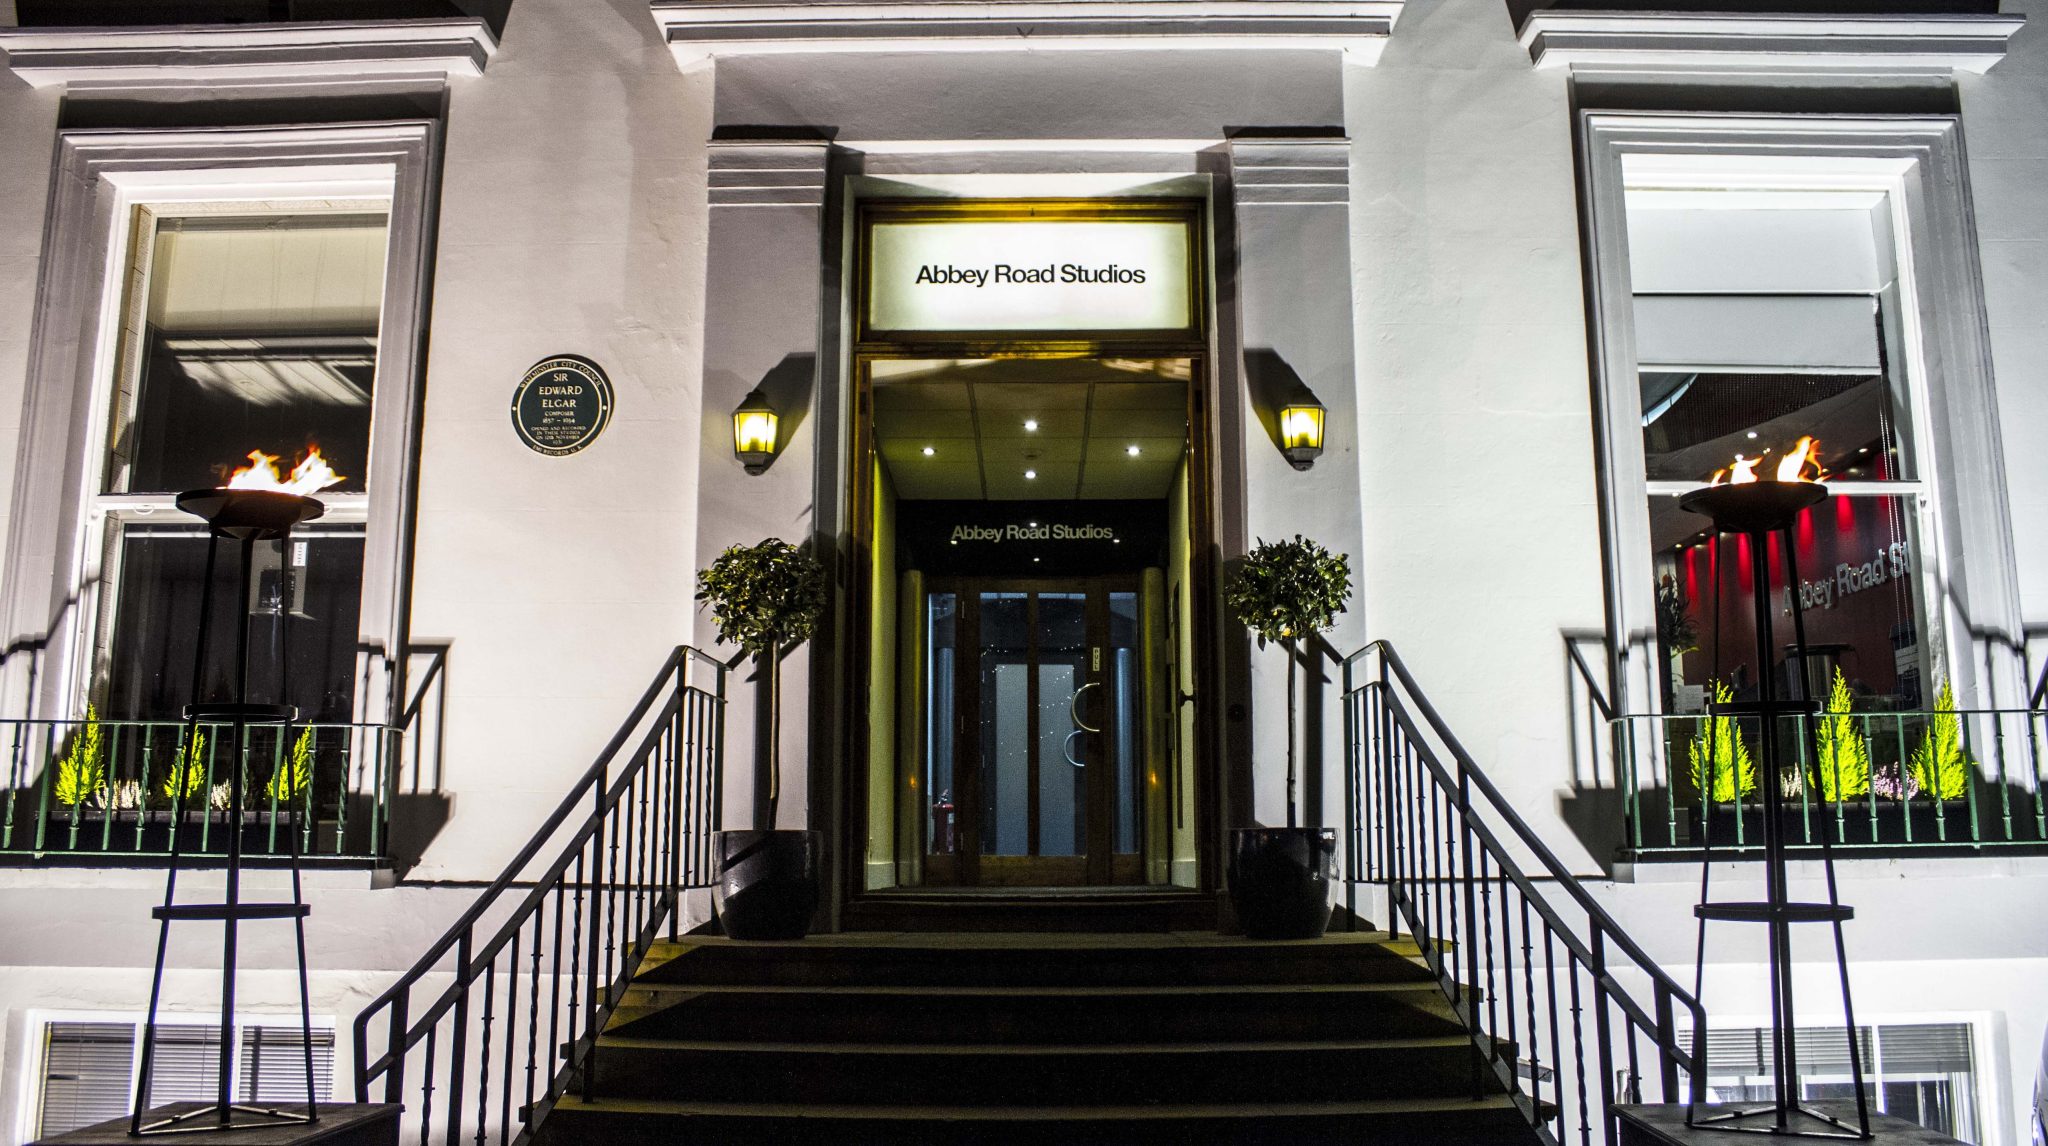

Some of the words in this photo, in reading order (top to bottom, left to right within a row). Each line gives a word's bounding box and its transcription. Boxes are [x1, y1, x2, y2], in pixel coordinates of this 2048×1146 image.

[915, 264, 989, 288] Abbey
[994, 264, 1055, 283] Road
[1060, 263, 1146, 283] Studios
[553, 372, 568, 382] SIR
[561, 361, 577, 369] CITY
[578, 365, 602, 387] COUNCIL
[538, 385, 583, 395] EDWARD
[542, 398, 577, 408] ELGAR
[951, 525, 1004, 543] Abbey
[1006, 525, 1050, 540] Road
[1052, 524, 1113, 540] Studios
[1836, 548, 1886, 598] Road
